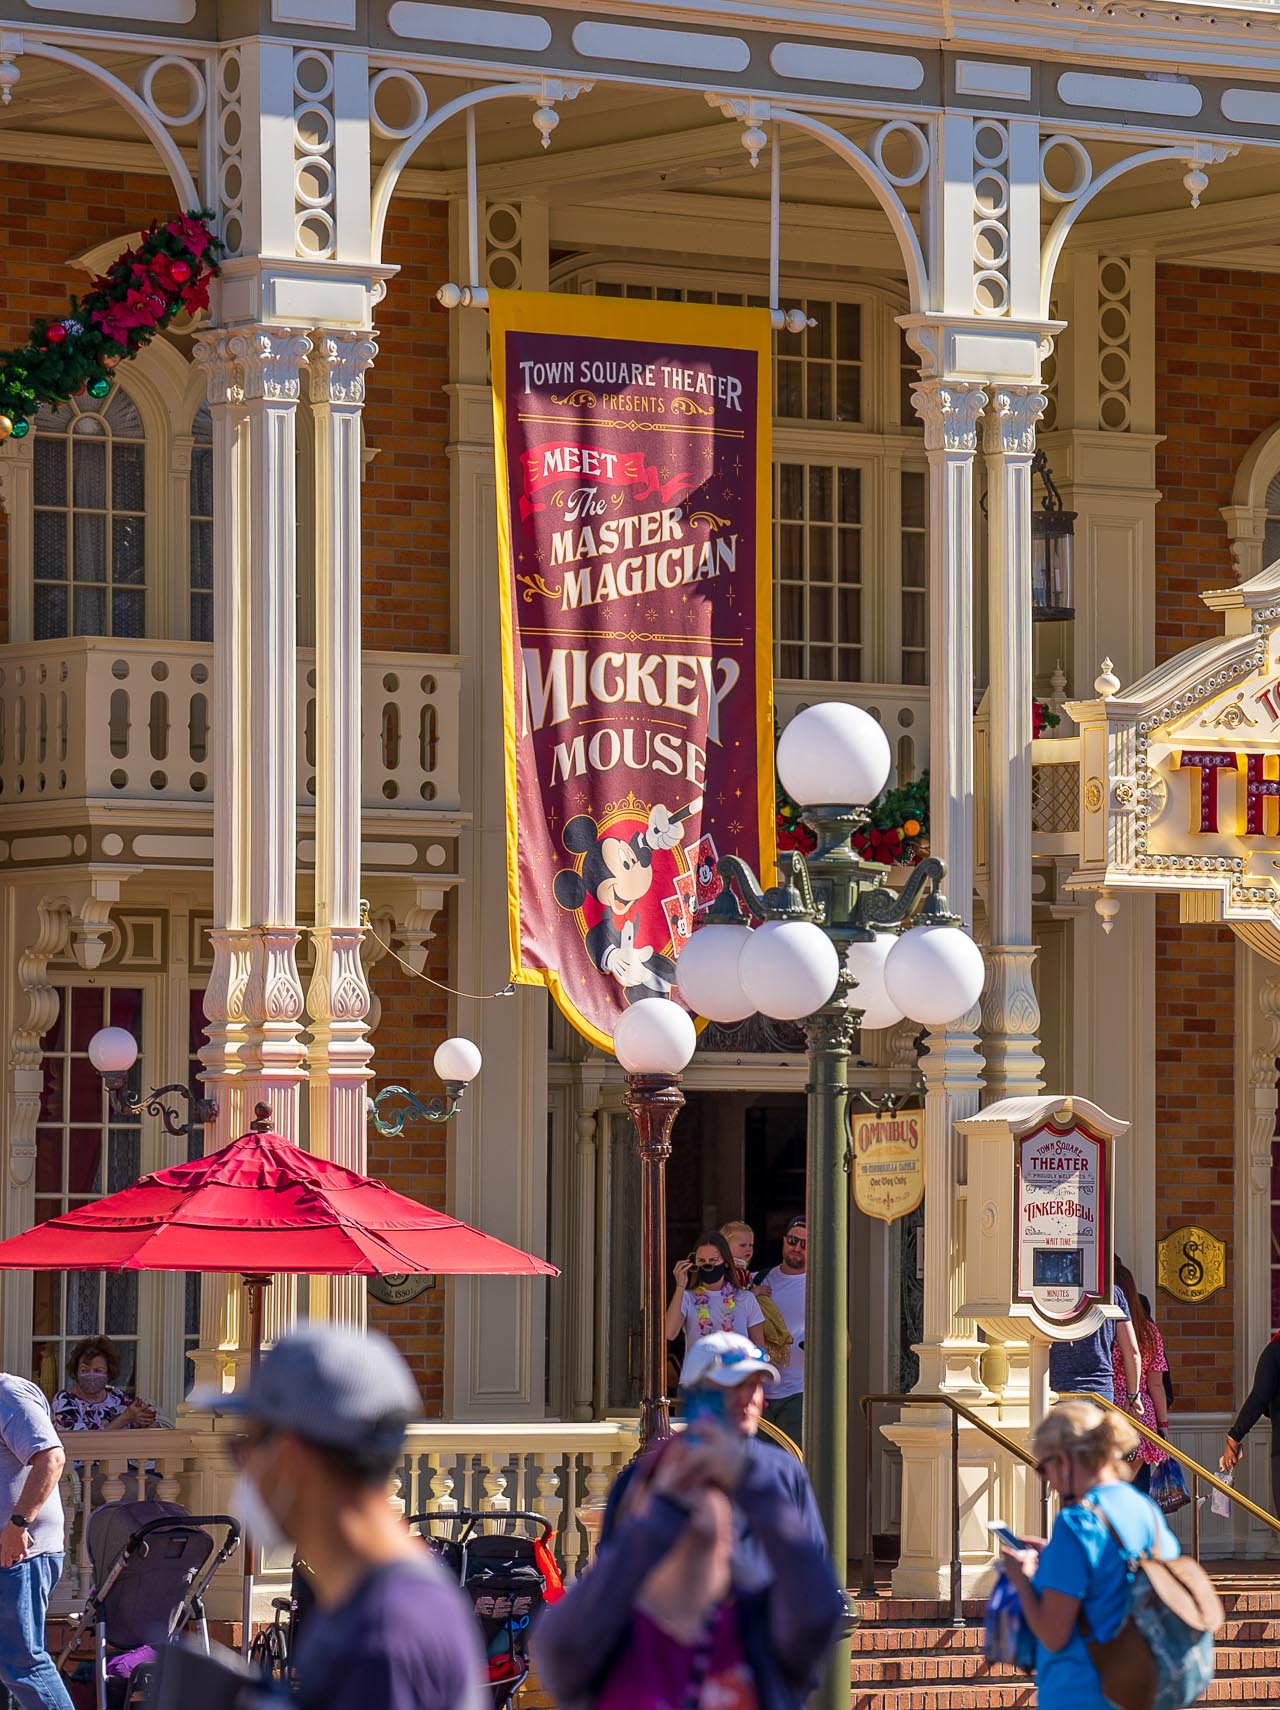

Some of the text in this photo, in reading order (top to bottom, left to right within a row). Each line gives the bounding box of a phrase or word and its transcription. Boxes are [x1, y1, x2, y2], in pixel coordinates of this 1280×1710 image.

[520, 360, 742, 411] TOWN SQUARE THEATER
[602, 393, 665, 414] PRESENTS
[542, 447, 618, 479] MEET
[563, 487, 608, 522] The
[549, 506, 685, 567] MASTER
[560, 533, 739, 612] MAGICIAN
[521, 647, 740, 748] MICKEY
[549, 728, 707, 792] MOUSE
[859, 1119, 918, 1152] OMNIBUS
[1036, 1140, 1083, 1157] TOWN SQUARE
[1030, 1157, 1089, 1171] THEATER
[1024, 1200, 1094, 1222] TINKER BELL
[1046, 1237, 1071, 1246] WAIT TIME
[1179, 1240, 1204, 1287] S
[1046, 1289, 1070, 1298] MINUTES
